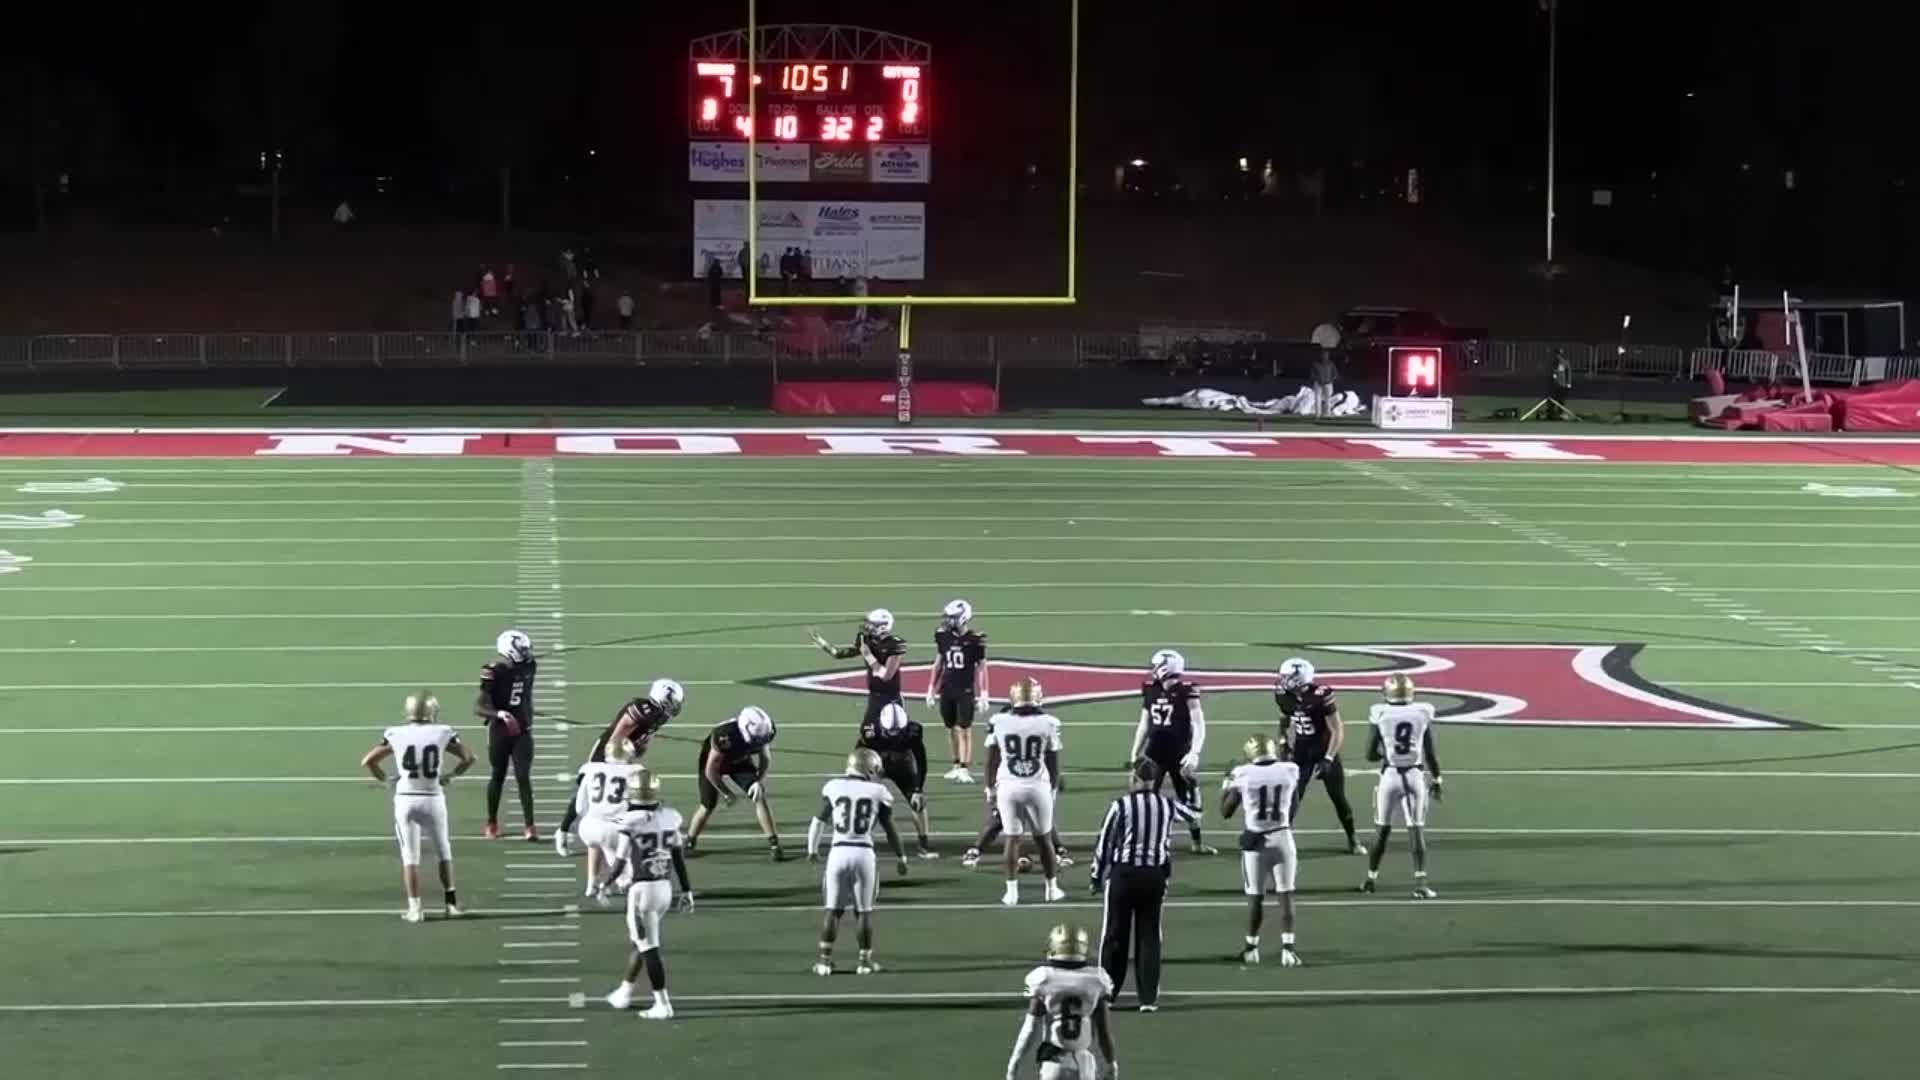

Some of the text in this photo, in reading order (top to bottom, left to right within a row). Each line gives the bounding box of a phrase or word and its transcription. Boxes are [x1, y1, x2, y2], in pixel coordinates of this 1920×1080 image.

[719, 76, 733, 98] 7
[902, 78, 918, 101] 0
[775, 116, 798, 139] 10
[821, 116, 853, 140] 32
[866, 116, 883, 140] 2
[692, 149, 744, 170] Hughes
[256, 432, 1605, 460] NORTH
[946, 650, 965, 669] 10
[509, 688, 524, 706] 5
[1151, 703, 1174, 726] 57
[1004, 733, 1042, 763] 90
[1395, 721, 1415, 755] 9
[401, 744, 440, 779] 40
[591, 772, 627, 804] 33
[1255, 784, 1284, 822] 11
[834, 796, 873, 835] 38
